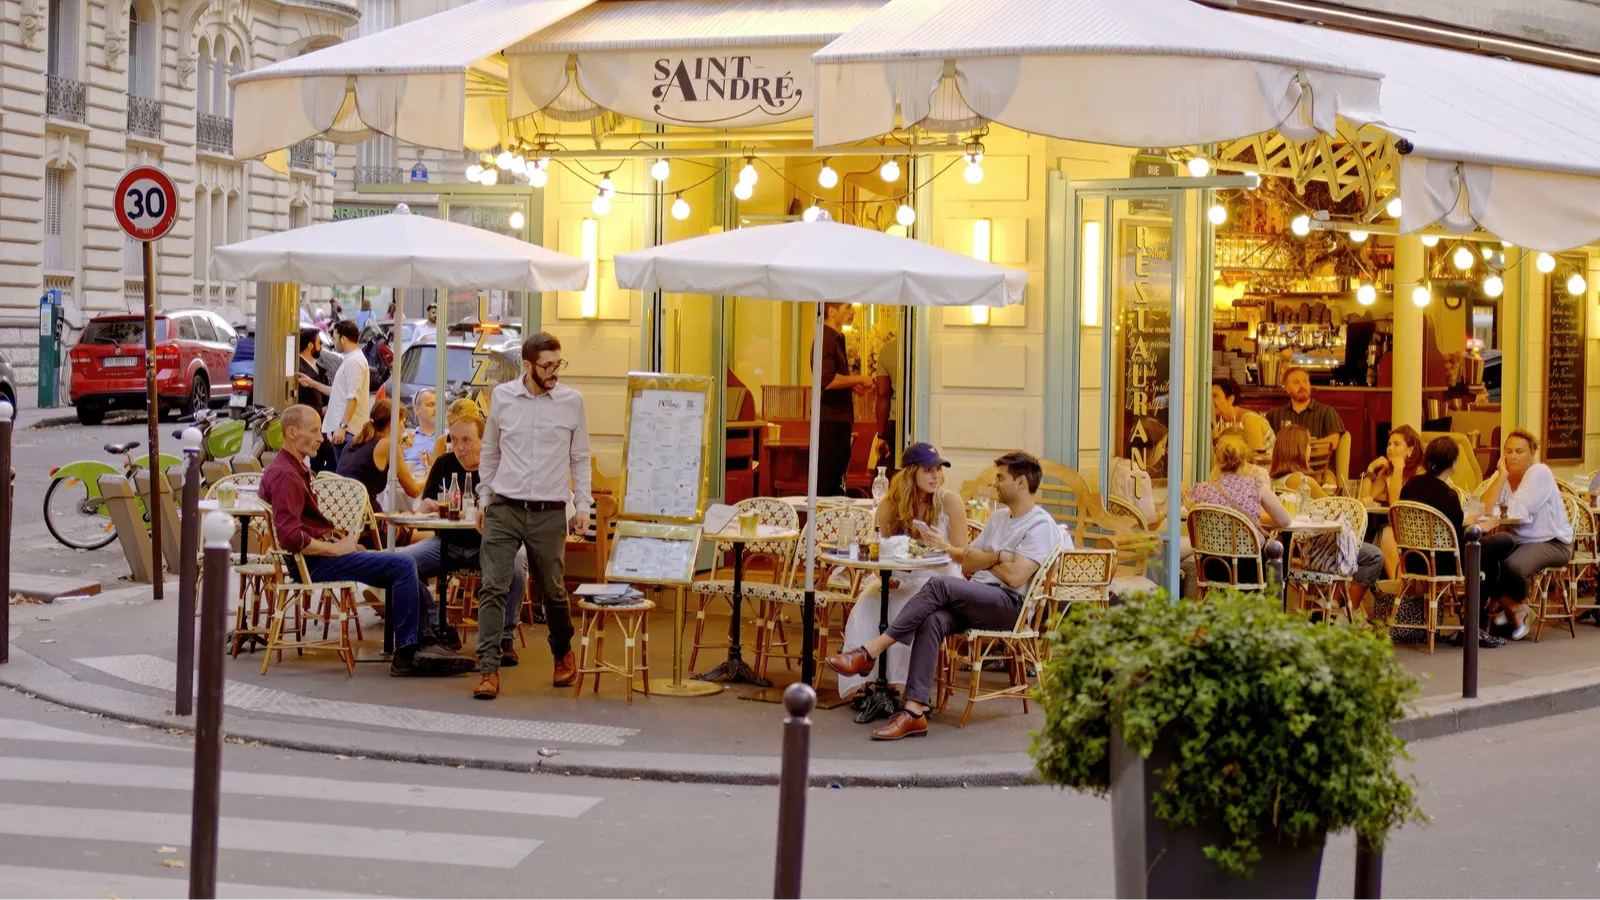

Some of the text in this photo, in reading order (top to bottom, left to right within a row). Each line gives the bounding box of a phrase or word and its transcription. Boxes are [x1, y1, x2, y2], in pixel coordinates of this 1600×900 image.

[127, 187, 165, 220] 30
[1147, 165, 1160, 176] RUE
[471, 289, 491, 419] IZZA
[1130, 226, 1149, 500] RESTAURANT
